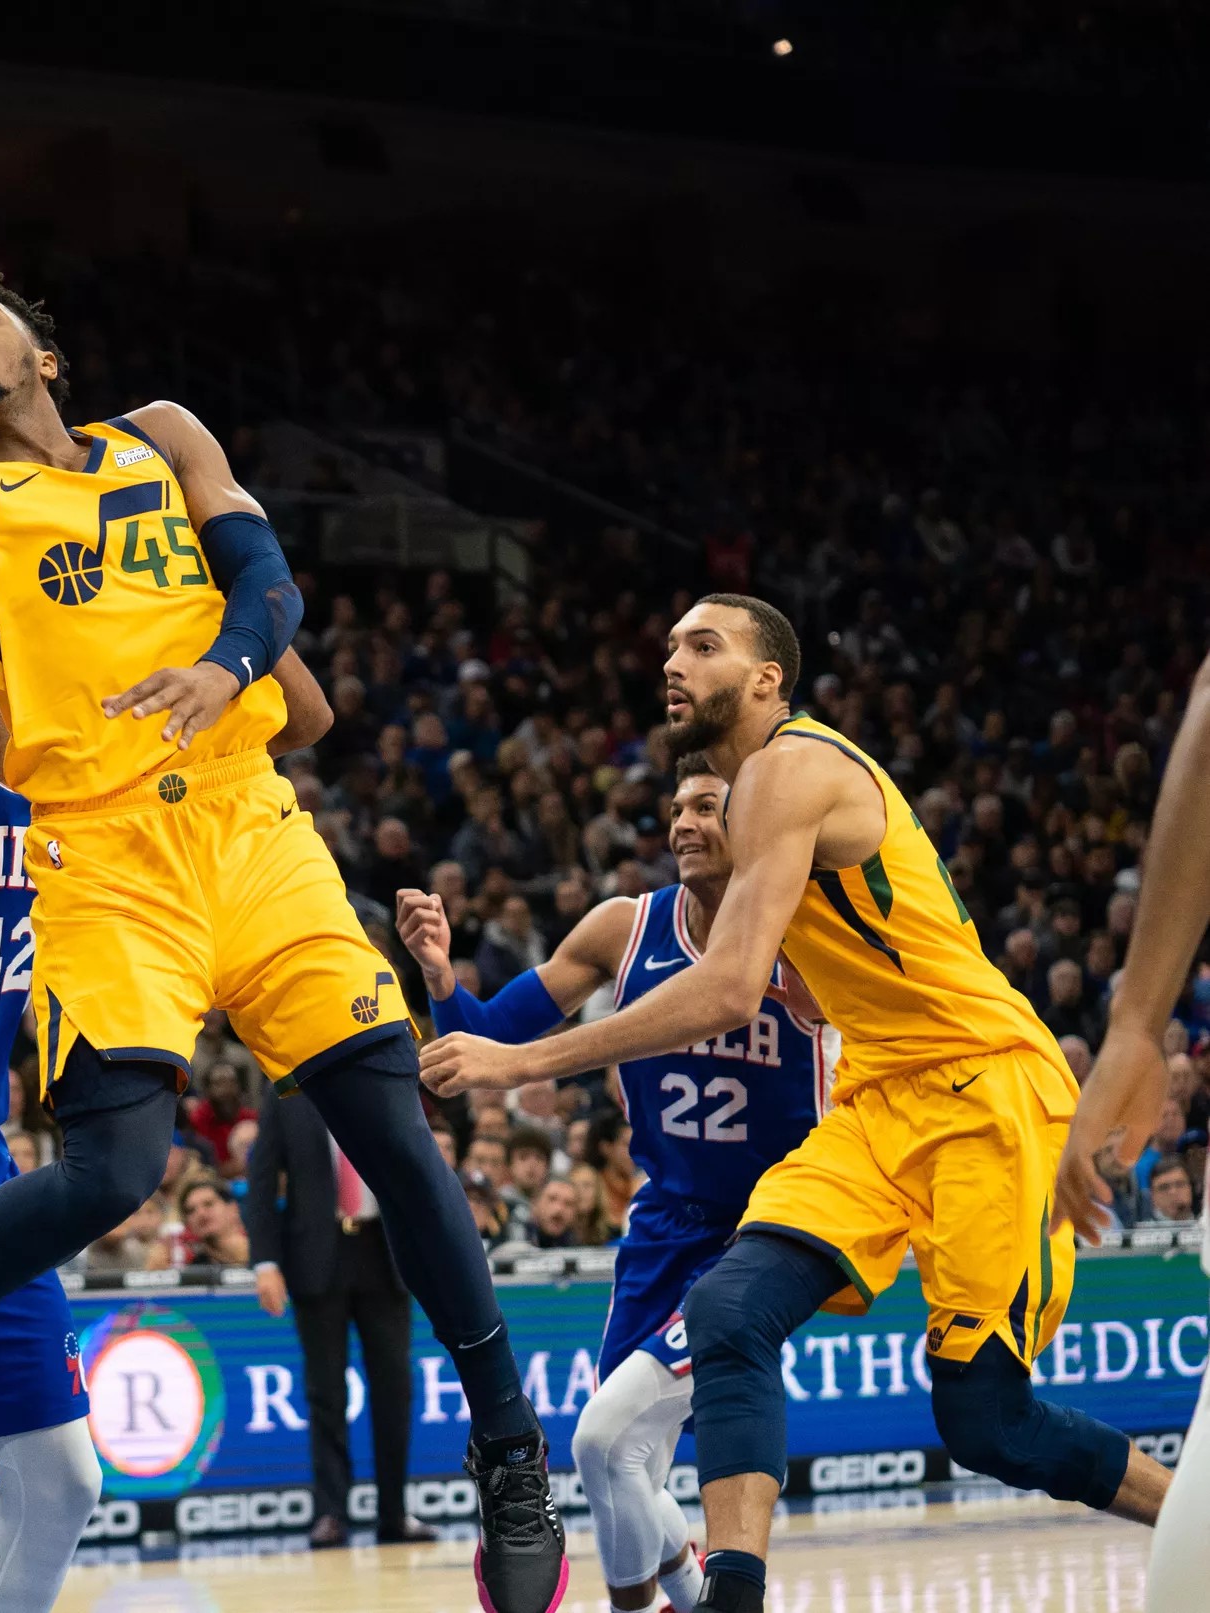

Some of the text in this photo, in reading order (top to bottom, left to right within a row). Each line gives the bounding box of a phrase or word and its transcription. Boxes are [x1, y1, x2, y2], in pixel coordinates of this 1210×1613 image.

[116, 453, 126, 466] 5
[120, 516, 209, 589] 45
[661, 1072, 748, 1142] 22
[117, 1369, 177, 1432] R
[810, 1450, 925, 1491] GEICO
[175, 1489, 314, 1536] GEICO
[346, 1478, 479, 1523] GICO
